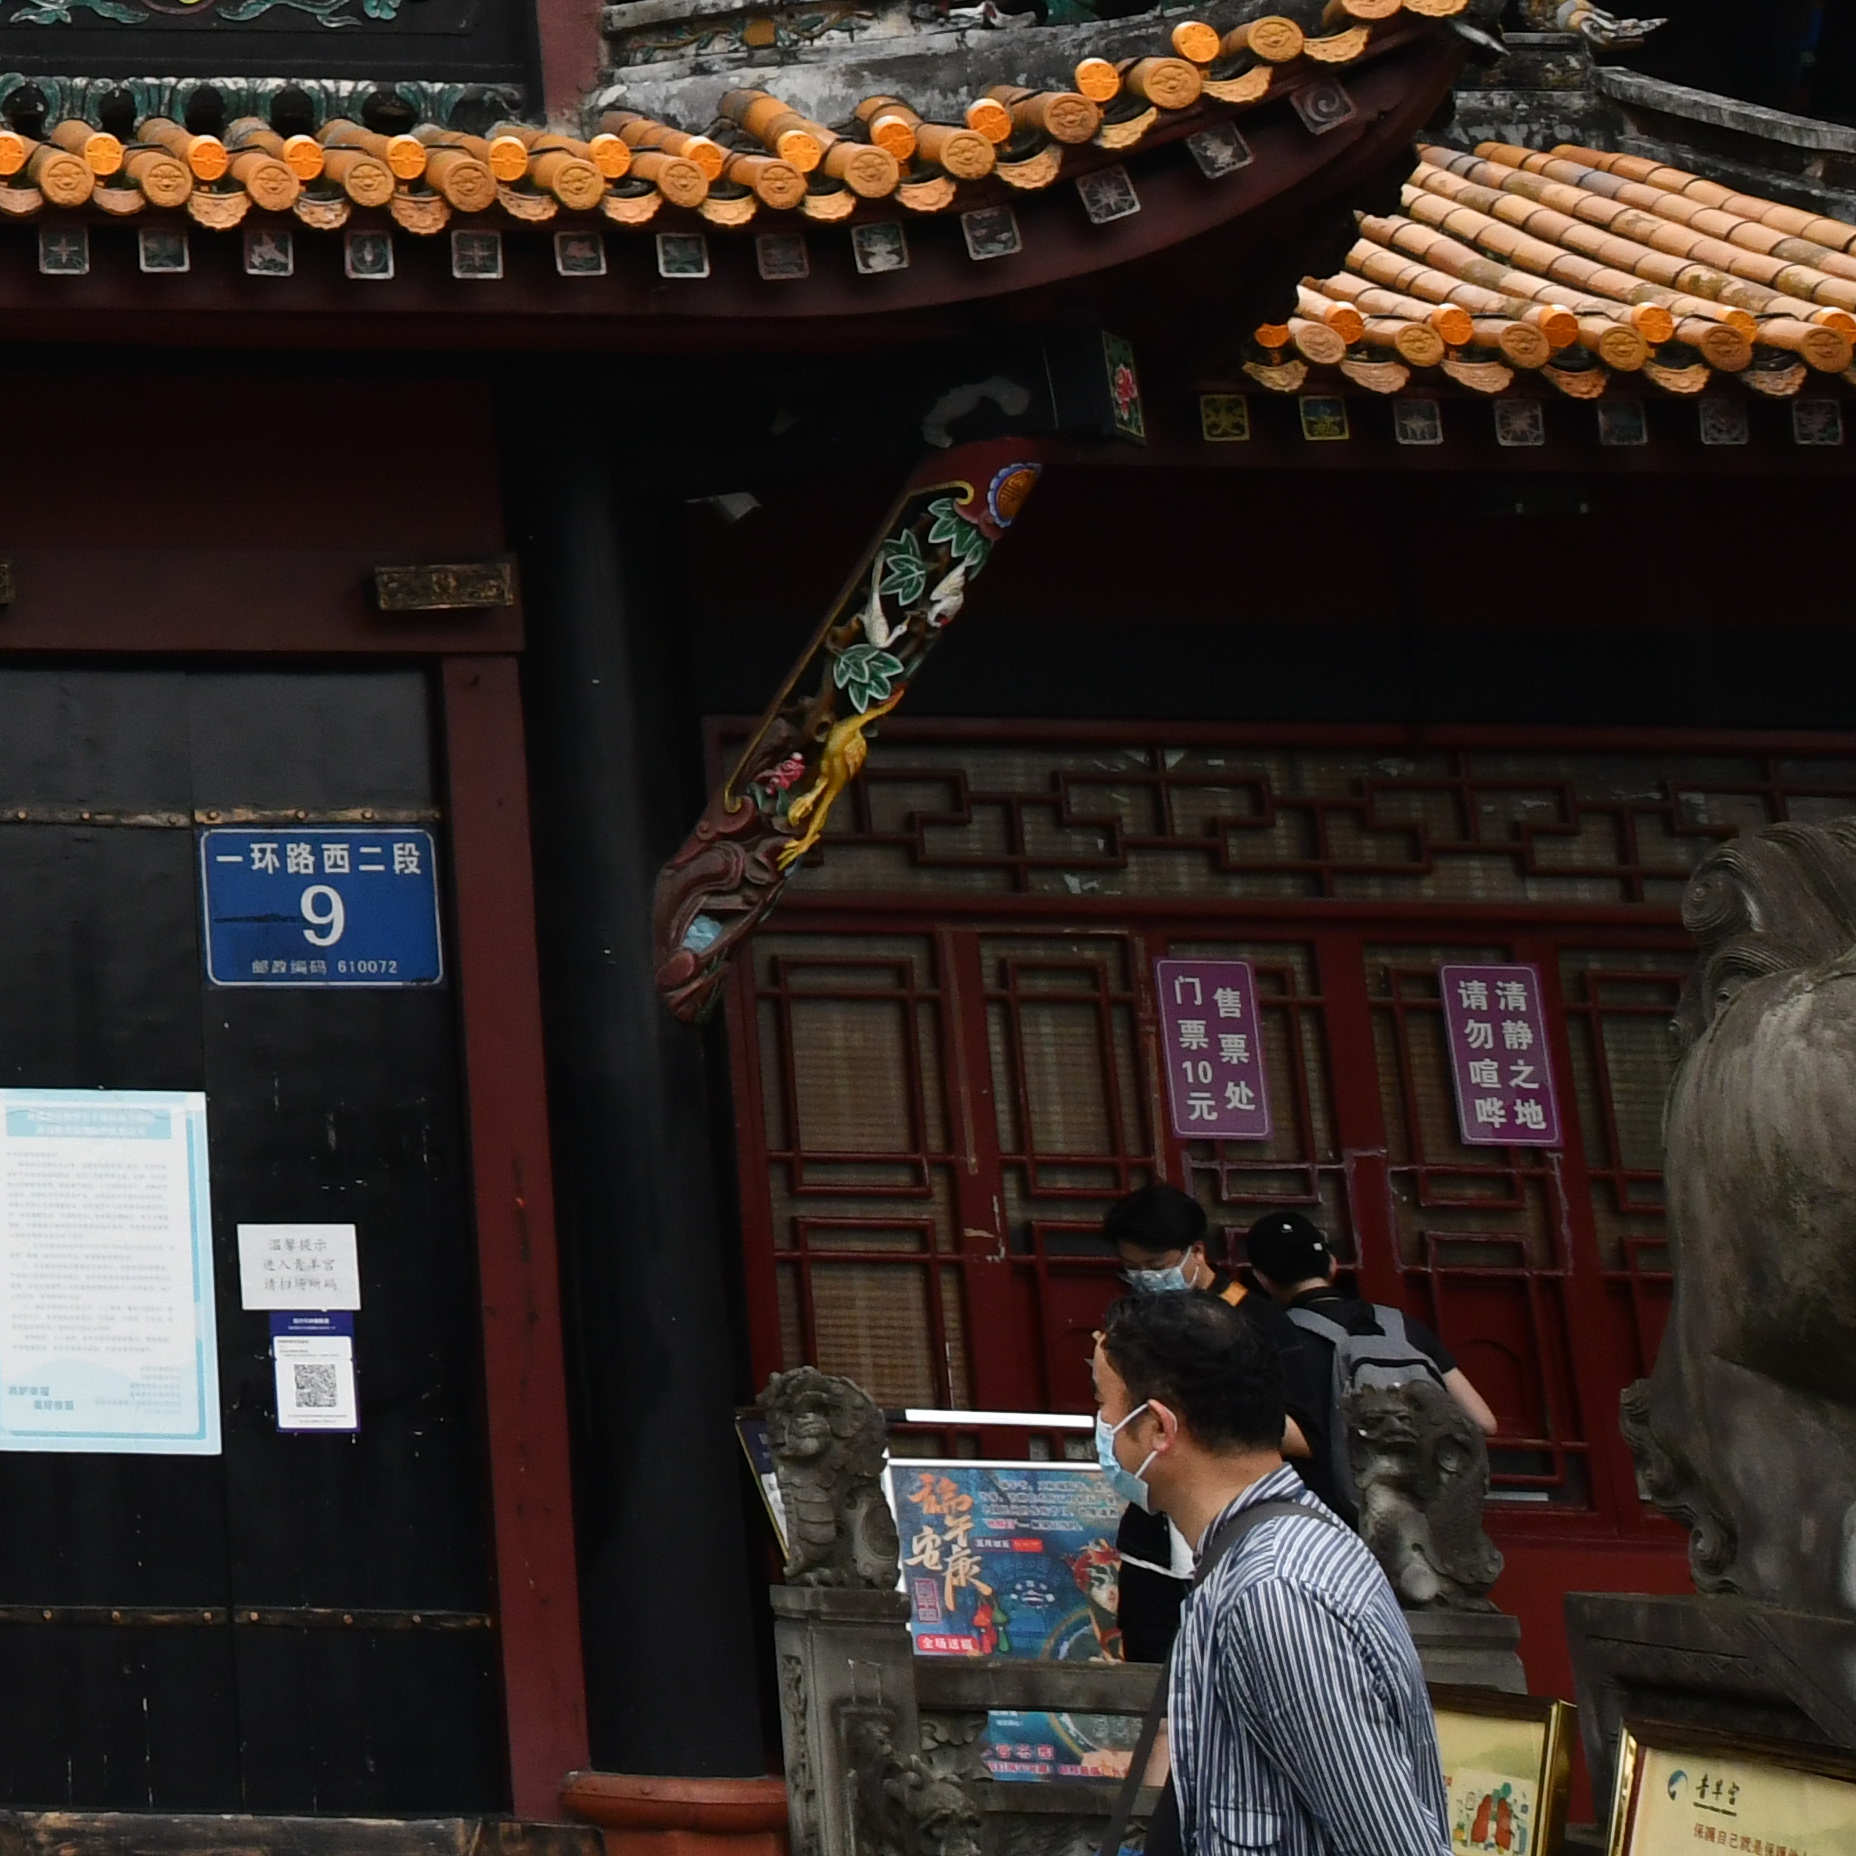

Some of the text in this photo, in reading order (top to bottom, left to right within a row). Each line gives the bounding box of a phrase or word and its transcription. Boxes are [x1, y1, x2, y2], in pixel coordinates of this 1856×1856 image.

[216, 842, 422, 875] 一环路西二段
[300, 884, 345, 946] 9
[251, 959, 398, 975] 邮政编码 610072
[1173, 975, 1219, 1122] 门票10元
[1213, 987, 1256, 1111] 售票处
[1457, 979, 1508, 1129] 请勿喧哗
[1495, 980, 1547, 1130] 清静之地
[268, 1238, 328, 1253] 温馨提示
